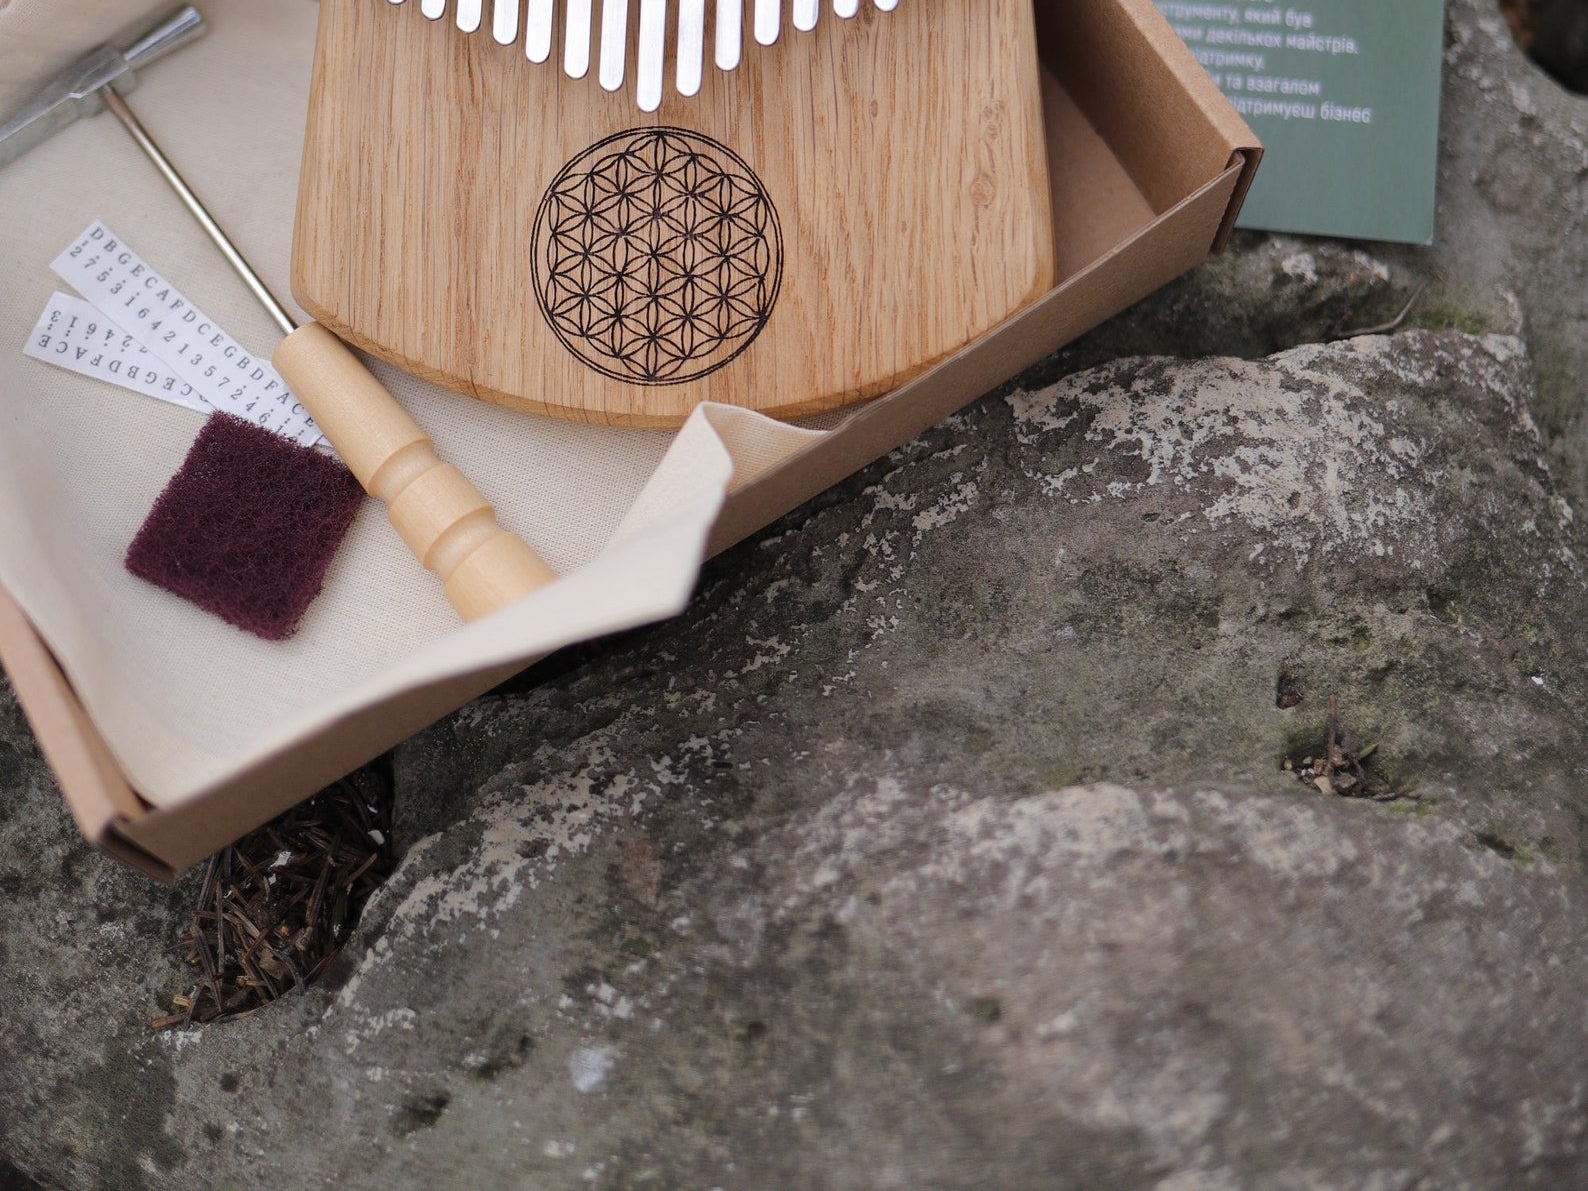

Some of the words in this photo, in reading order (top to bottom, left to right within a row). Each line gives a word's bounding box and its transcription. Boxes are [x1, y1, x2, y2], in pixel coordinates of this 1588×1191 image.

[1285, 7, 1313, 30] був
[1205, 27, 1282, 49] декількох
[1320, 100, 1372, 125] бізнес
